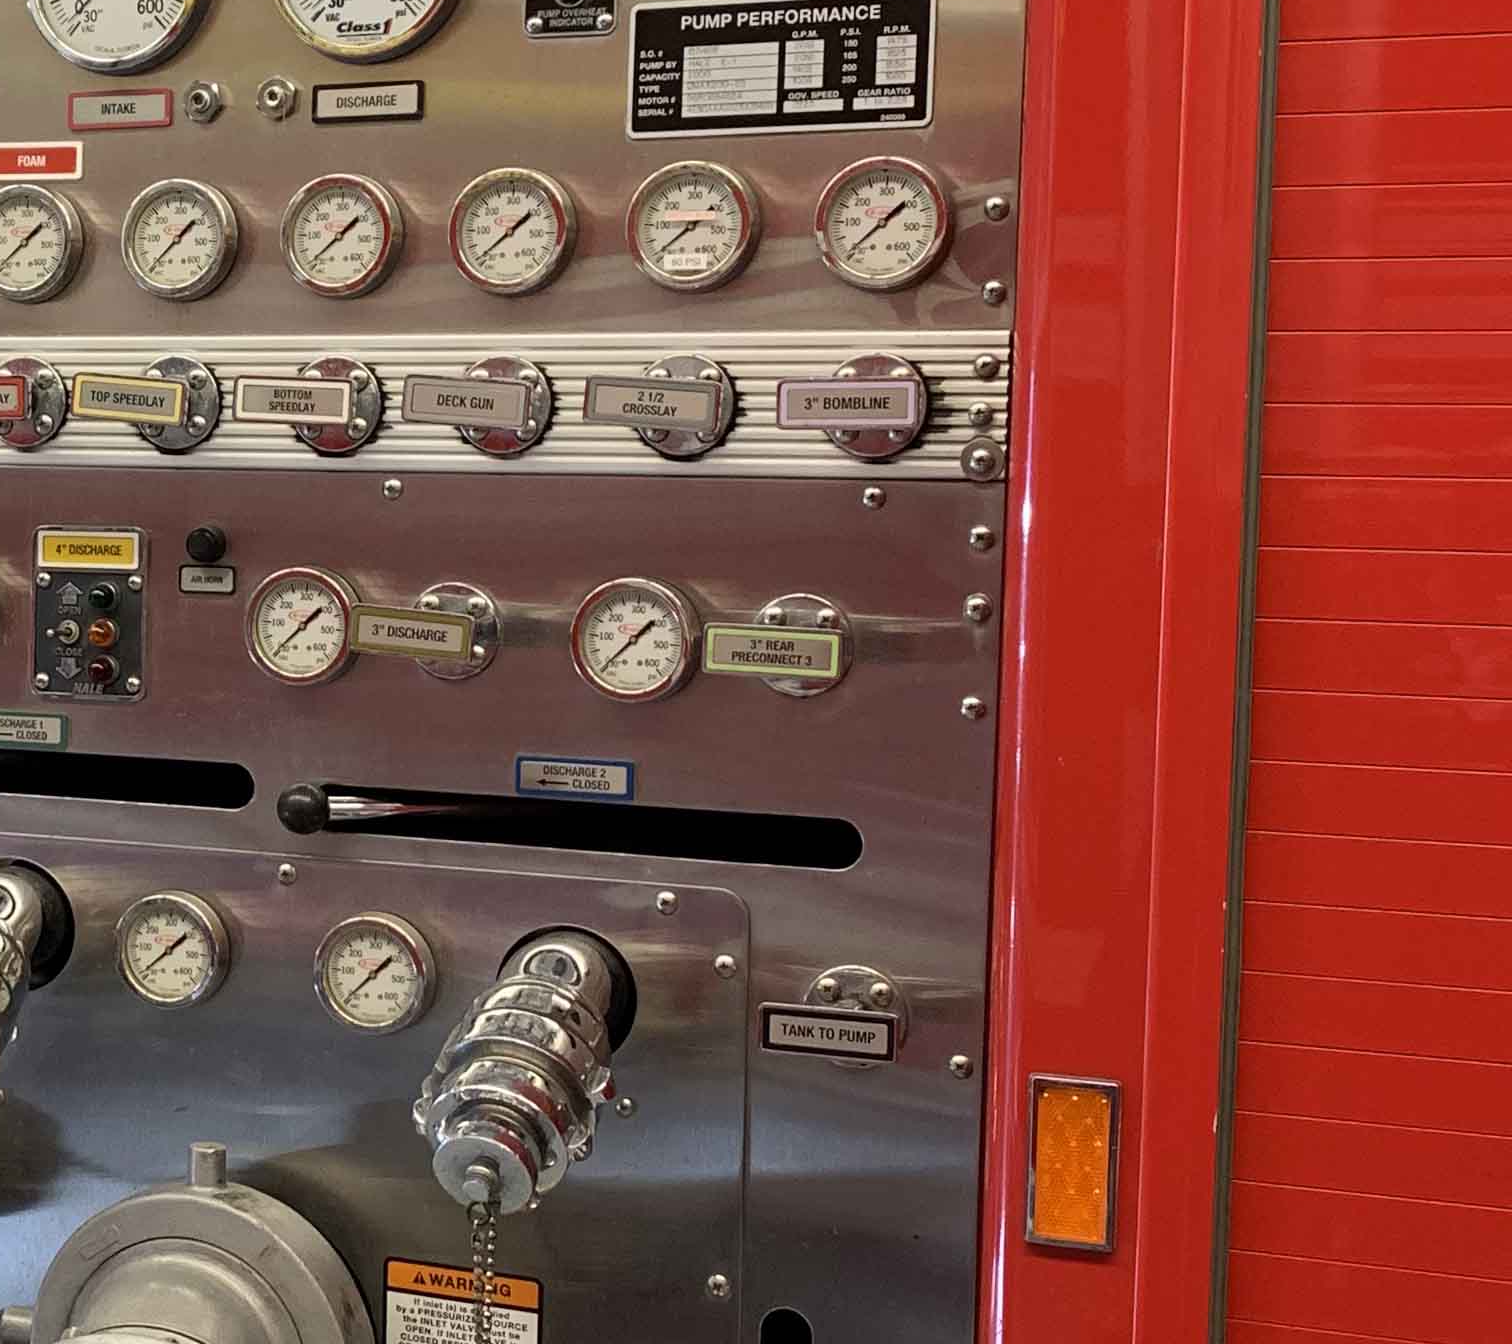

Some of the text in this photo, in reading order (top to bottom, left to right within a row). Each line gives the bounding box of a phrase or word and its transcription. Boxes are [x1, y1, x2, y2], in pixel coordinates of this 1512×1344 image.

[75, 0, 84, 13] 0
[326, 13, 340, 22] VAC
[537, 8, 607, 18] PUMP OVERHEAT
[681, 5, 881, 30] PUMP PERFORMANCE
[549, 16, 594, 27] INDICATOR
[844, 39, 858, 47] 150
[640, 62, 664, 70] PUMP
[639, 73, 680, 81] CAPACITY
[884, 88, 911, 96] RATIO
[336, 95, 397, 108] DISCHARGE
[638, 97, 669, 105] MOTOR
[101, 102, 137, 114] INTAKE
[17, 155, 46, 168] FOAM
[91, 392, 165, 409] TOP SPEEDLAY
[273, 389, 312, 400] BOTTOM
[637, 392, 664, 403] 2 1/2
[268, 401, 315, 413] SPEEDLAY
[437, 395, 494, 411] DECK GUN
[804, 396, 890, 411] 3" BOMBLINE
[622, 403, 677, 416] CROSSLAY
[56, 544, 122, 556] 4" DISCHARGE
[57, 607, 82, 616] OPEN
[371, 624, 448, 643] 3" DISCHARGE
[750, 639, 794, 652] 3" REAR
[56, 648, 82, 657] CLOSE
[731, 651, 812, 666] PRECONNECT 3
[73, 682, 104, 694] HALE
[16, 731, 47, 741] CLOSED
[543, 765, 606, 778] DISCHARGE 2
[572, 779, 610, 790] CLOSED
[782, 1024, 875, 1044] TANK TO PUMP
[430, 1274, 511, 1296] WARNG
[420, 1317, 447, 1328] INLET
[400, 1332, 438, 1344] CLOSED
